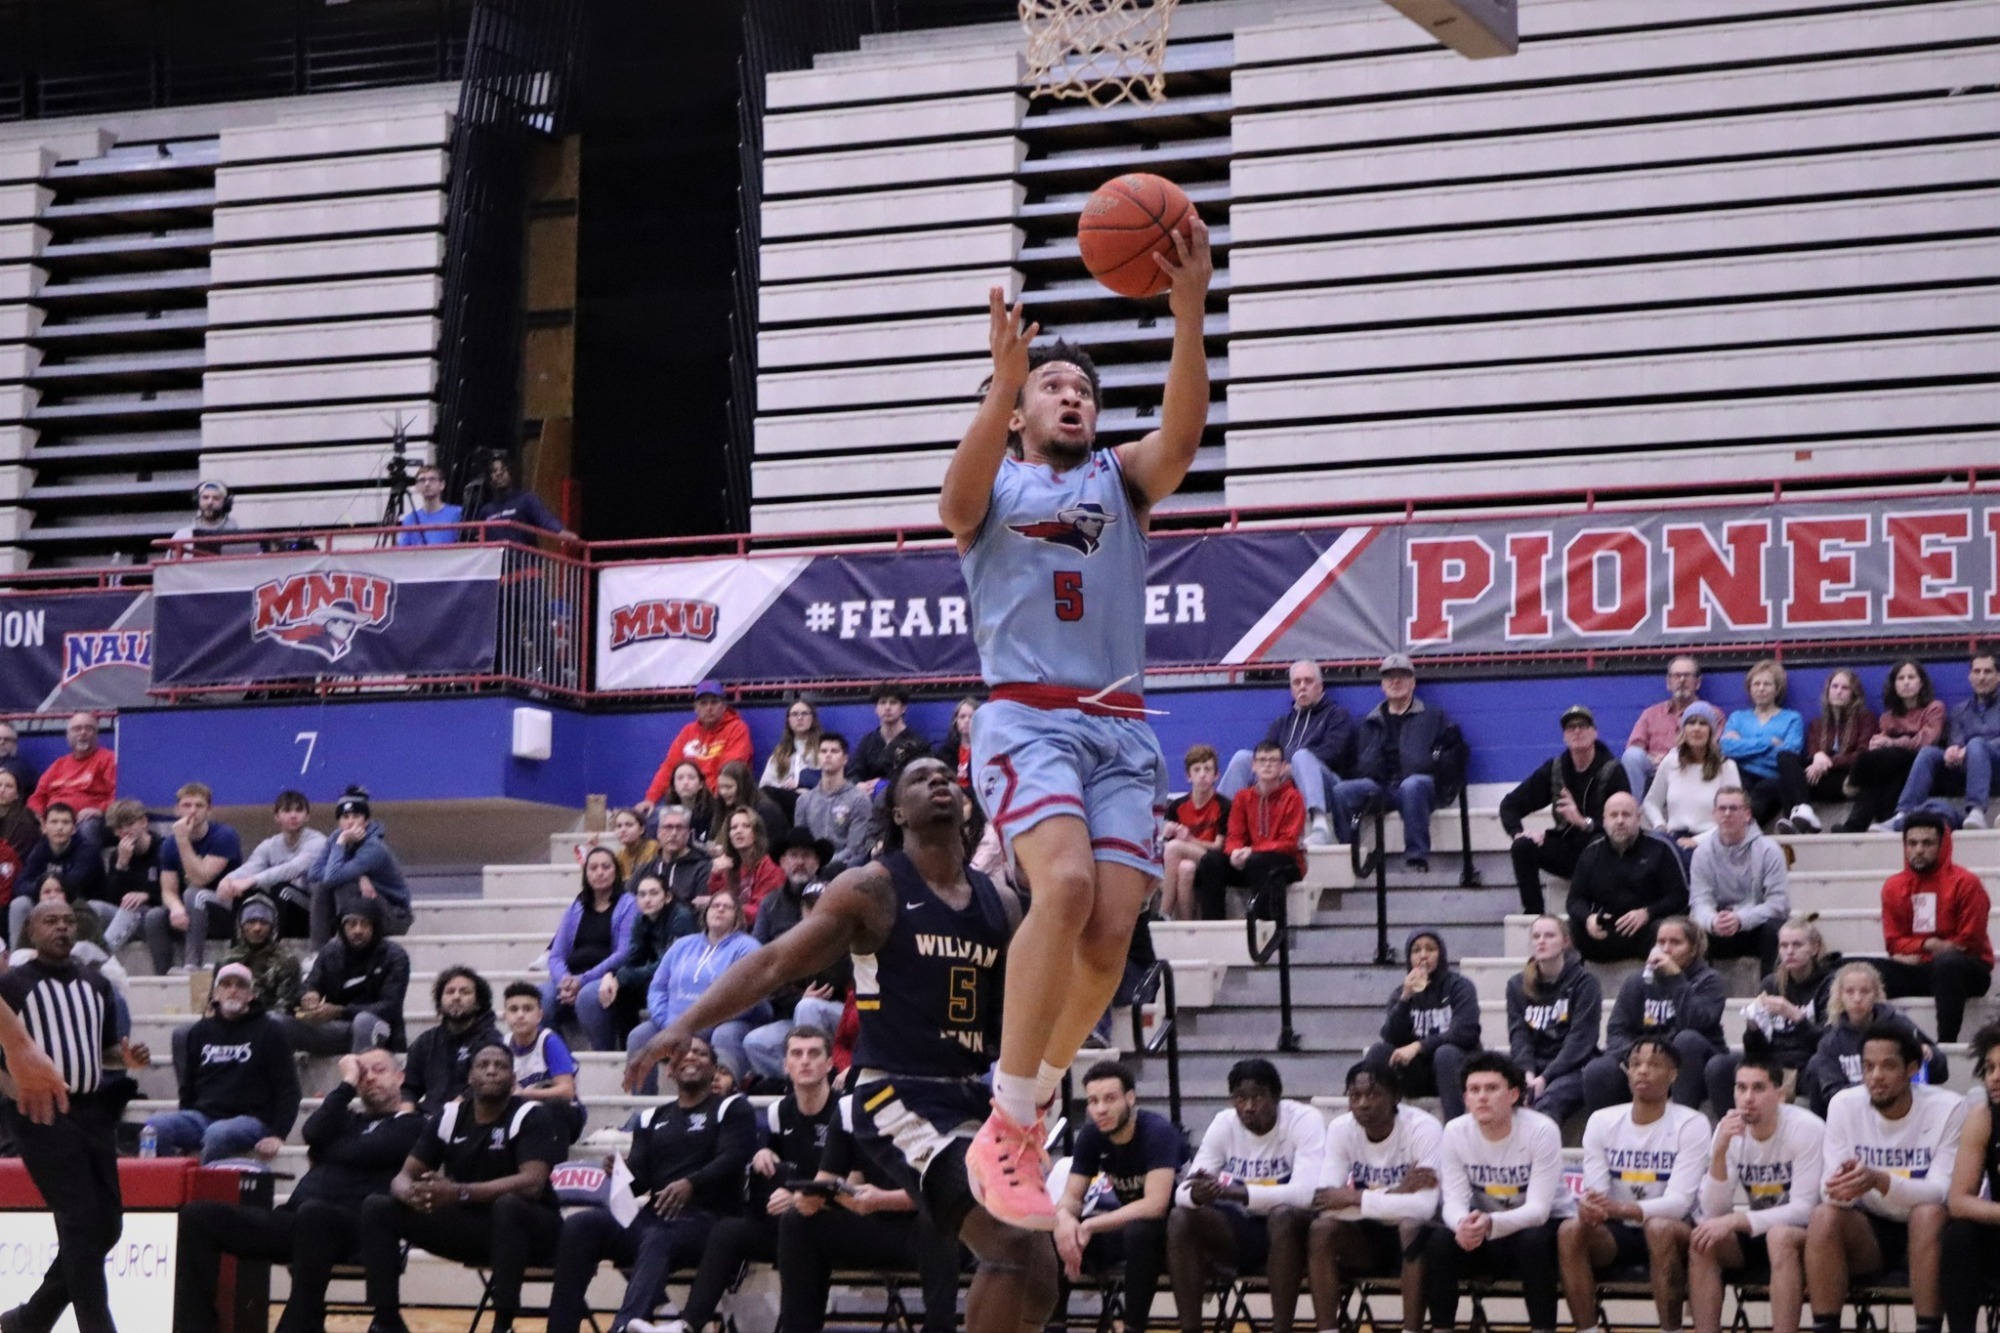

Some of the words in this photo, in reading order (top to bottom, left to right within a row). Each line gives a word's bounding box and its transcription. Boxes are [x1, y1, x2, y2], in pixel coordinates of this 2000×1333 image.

[254, 570, 391, 635] MNU
[1053, 570, 1084, 622] 5
[1405, 507, 2000, 646] PIONEE
[610, 598, 719, 652] MNU
[294, 731, 318, 775] 7
[948, 966, 977, 1022] 5
[550, 1166, 606, 1192] MNU
[104, 1243, 169, 1278] HURCH
